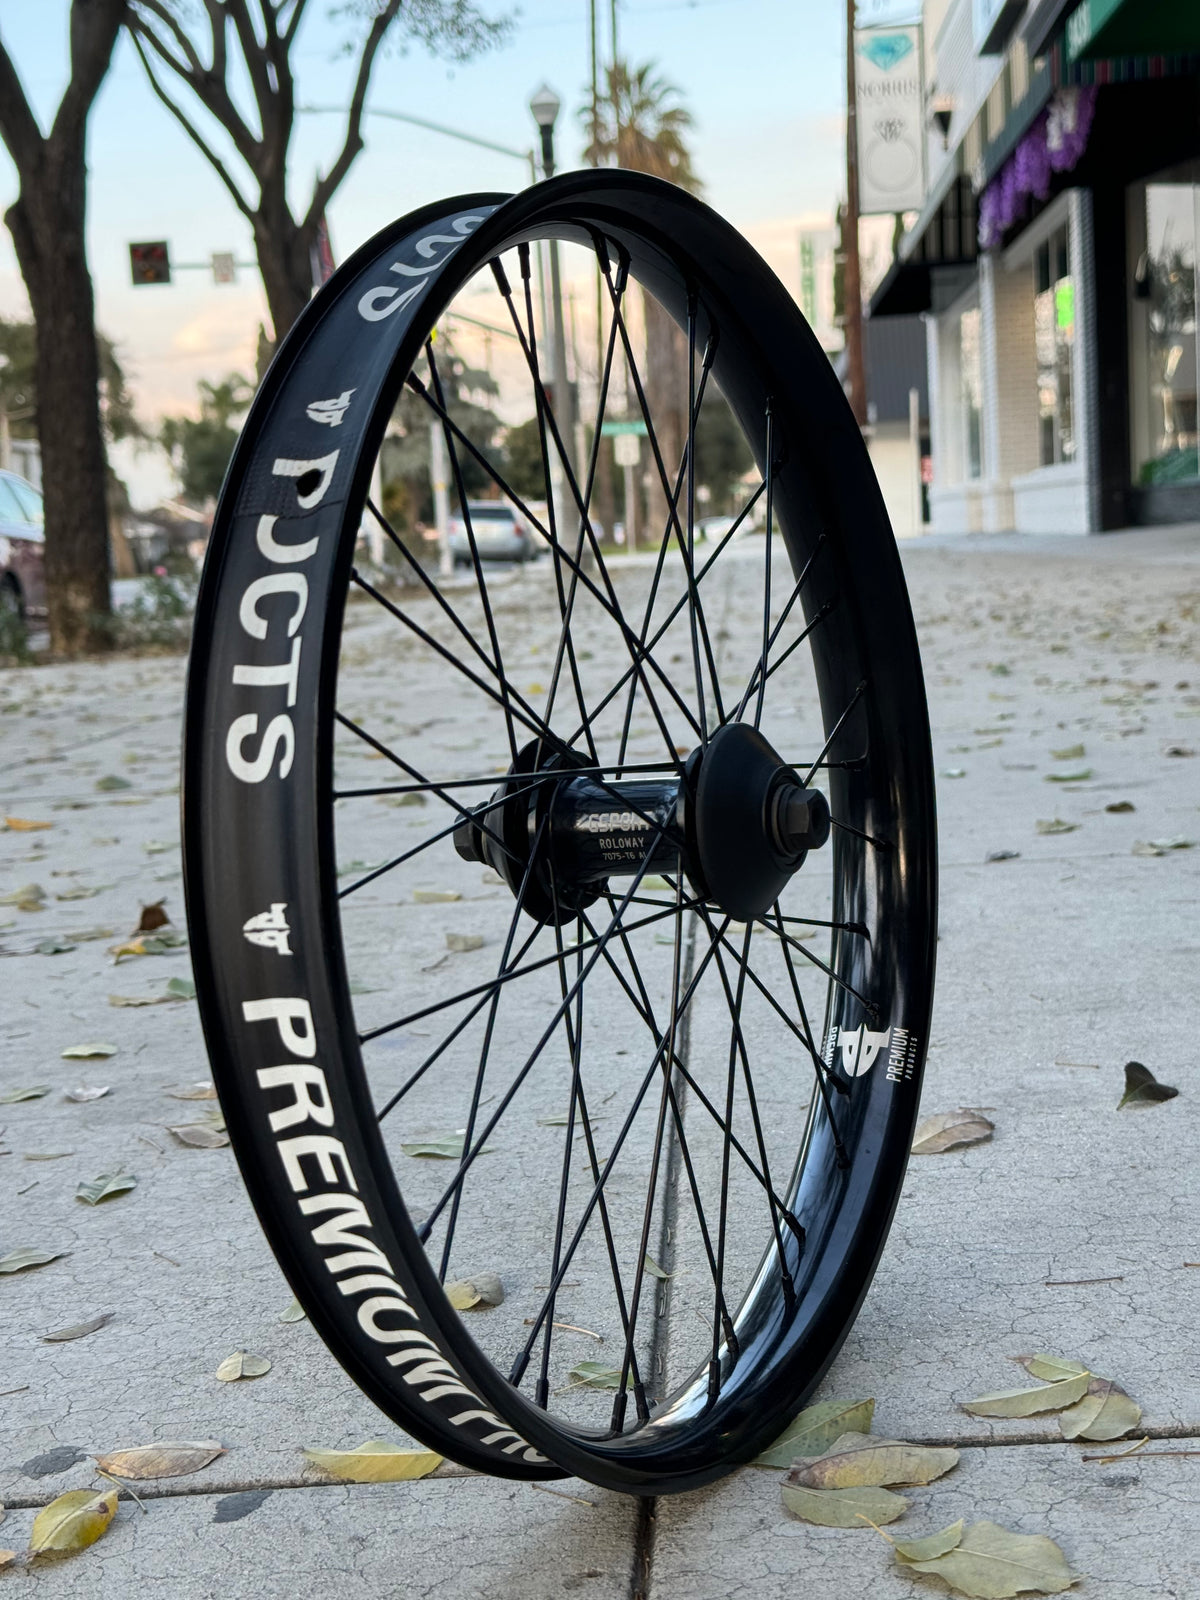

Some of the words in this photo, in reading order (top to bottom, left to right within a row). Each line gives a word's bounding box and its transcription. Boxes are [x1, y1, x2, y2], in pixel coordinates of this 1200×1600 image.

[599, 837, 645, 849] ROLOWAY
[602, 852, 636, 860] 7075-T6
[886, 1027, 909, 1083] PREMIUM
[241, 997, 488, 1408] PREMIUM
